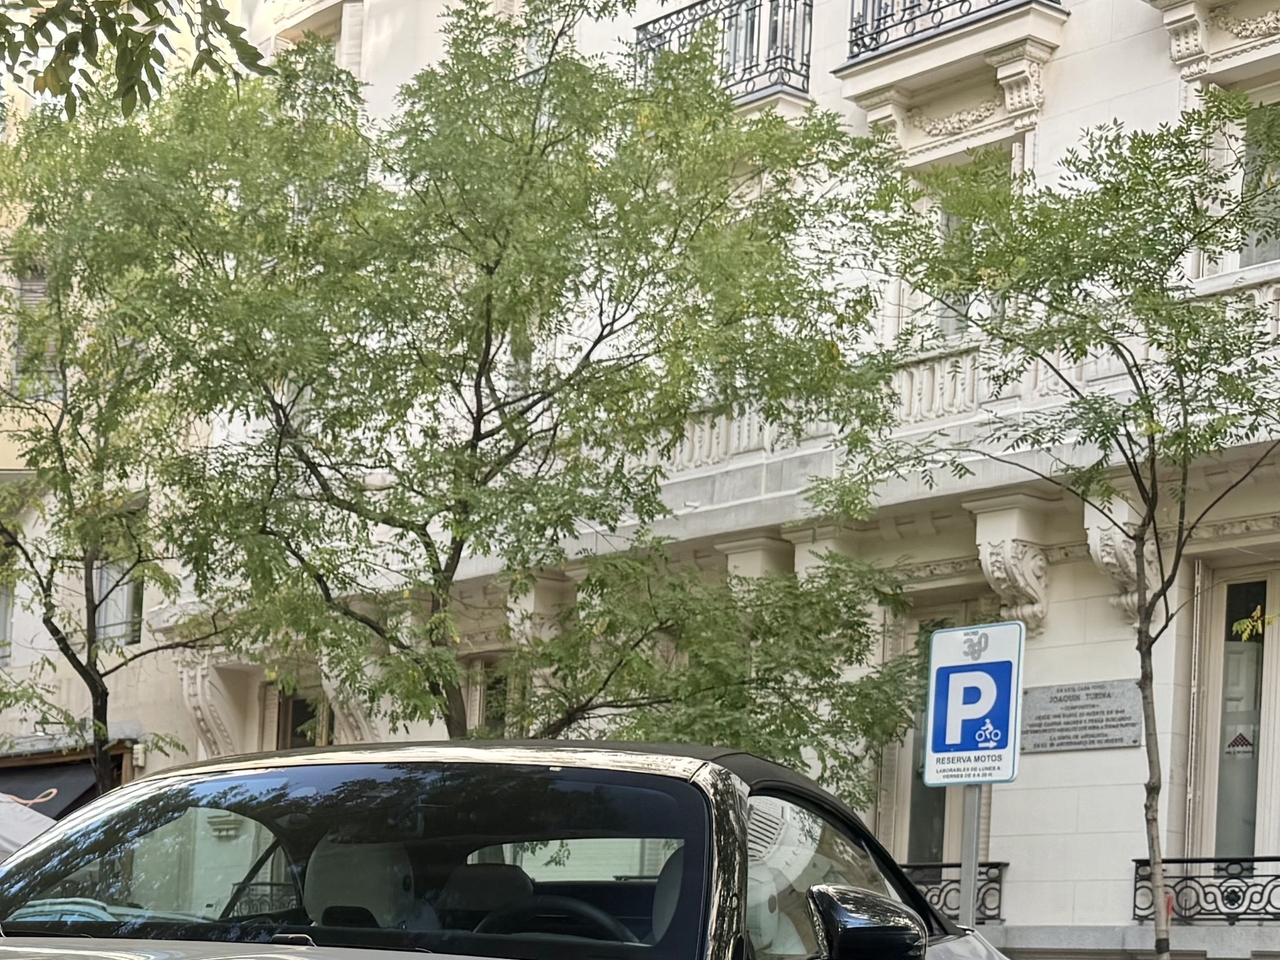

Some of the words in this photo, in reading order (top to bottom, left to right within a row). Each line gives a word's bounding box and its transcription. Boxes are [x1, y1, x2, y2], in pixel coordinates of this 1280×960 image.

[945, 670, 998, 745] P
[935, 755, 972, 765] RESERVA
[973, 754, 1003, 763] MOTOS
